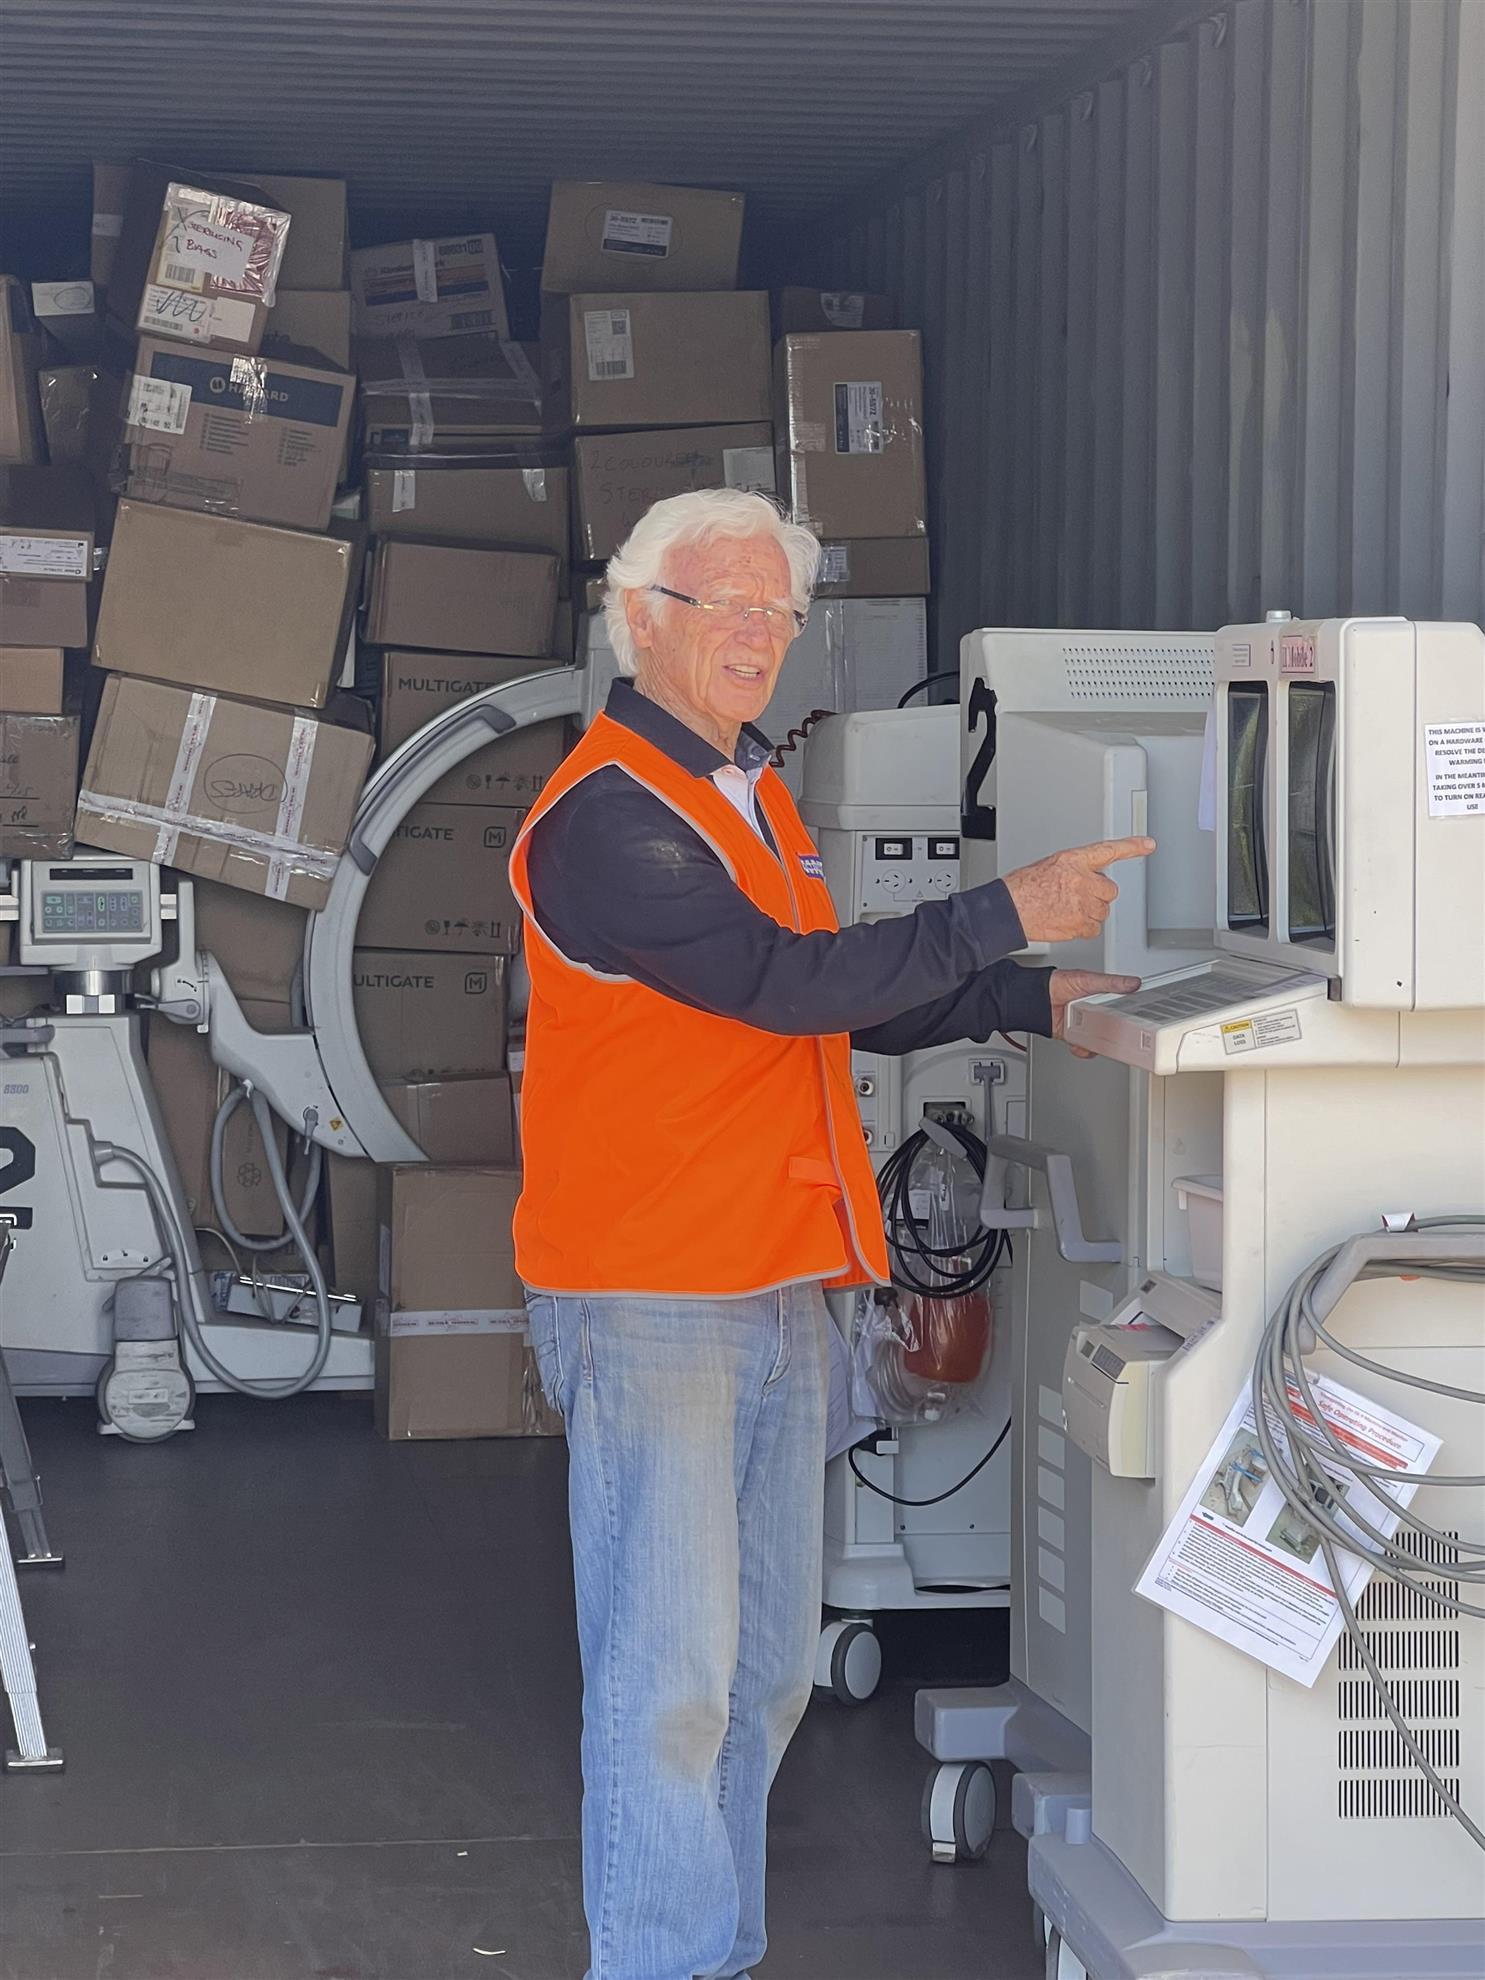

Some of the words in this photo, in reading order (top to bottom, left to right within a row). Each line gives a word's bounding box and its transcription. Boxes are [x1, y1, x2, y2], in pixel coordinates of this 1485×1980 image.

[1449, 758, 1482, 766] WARMING
[394, 825, 454, 840] TIGATE
[353, 974, 434, 988] ULTIGATE
[1318, 1401, 1333, 1413] Safe
[1333, 1409, 1368, 1431] Operating
[1367, 1427, 1403, 1449] Procedure
